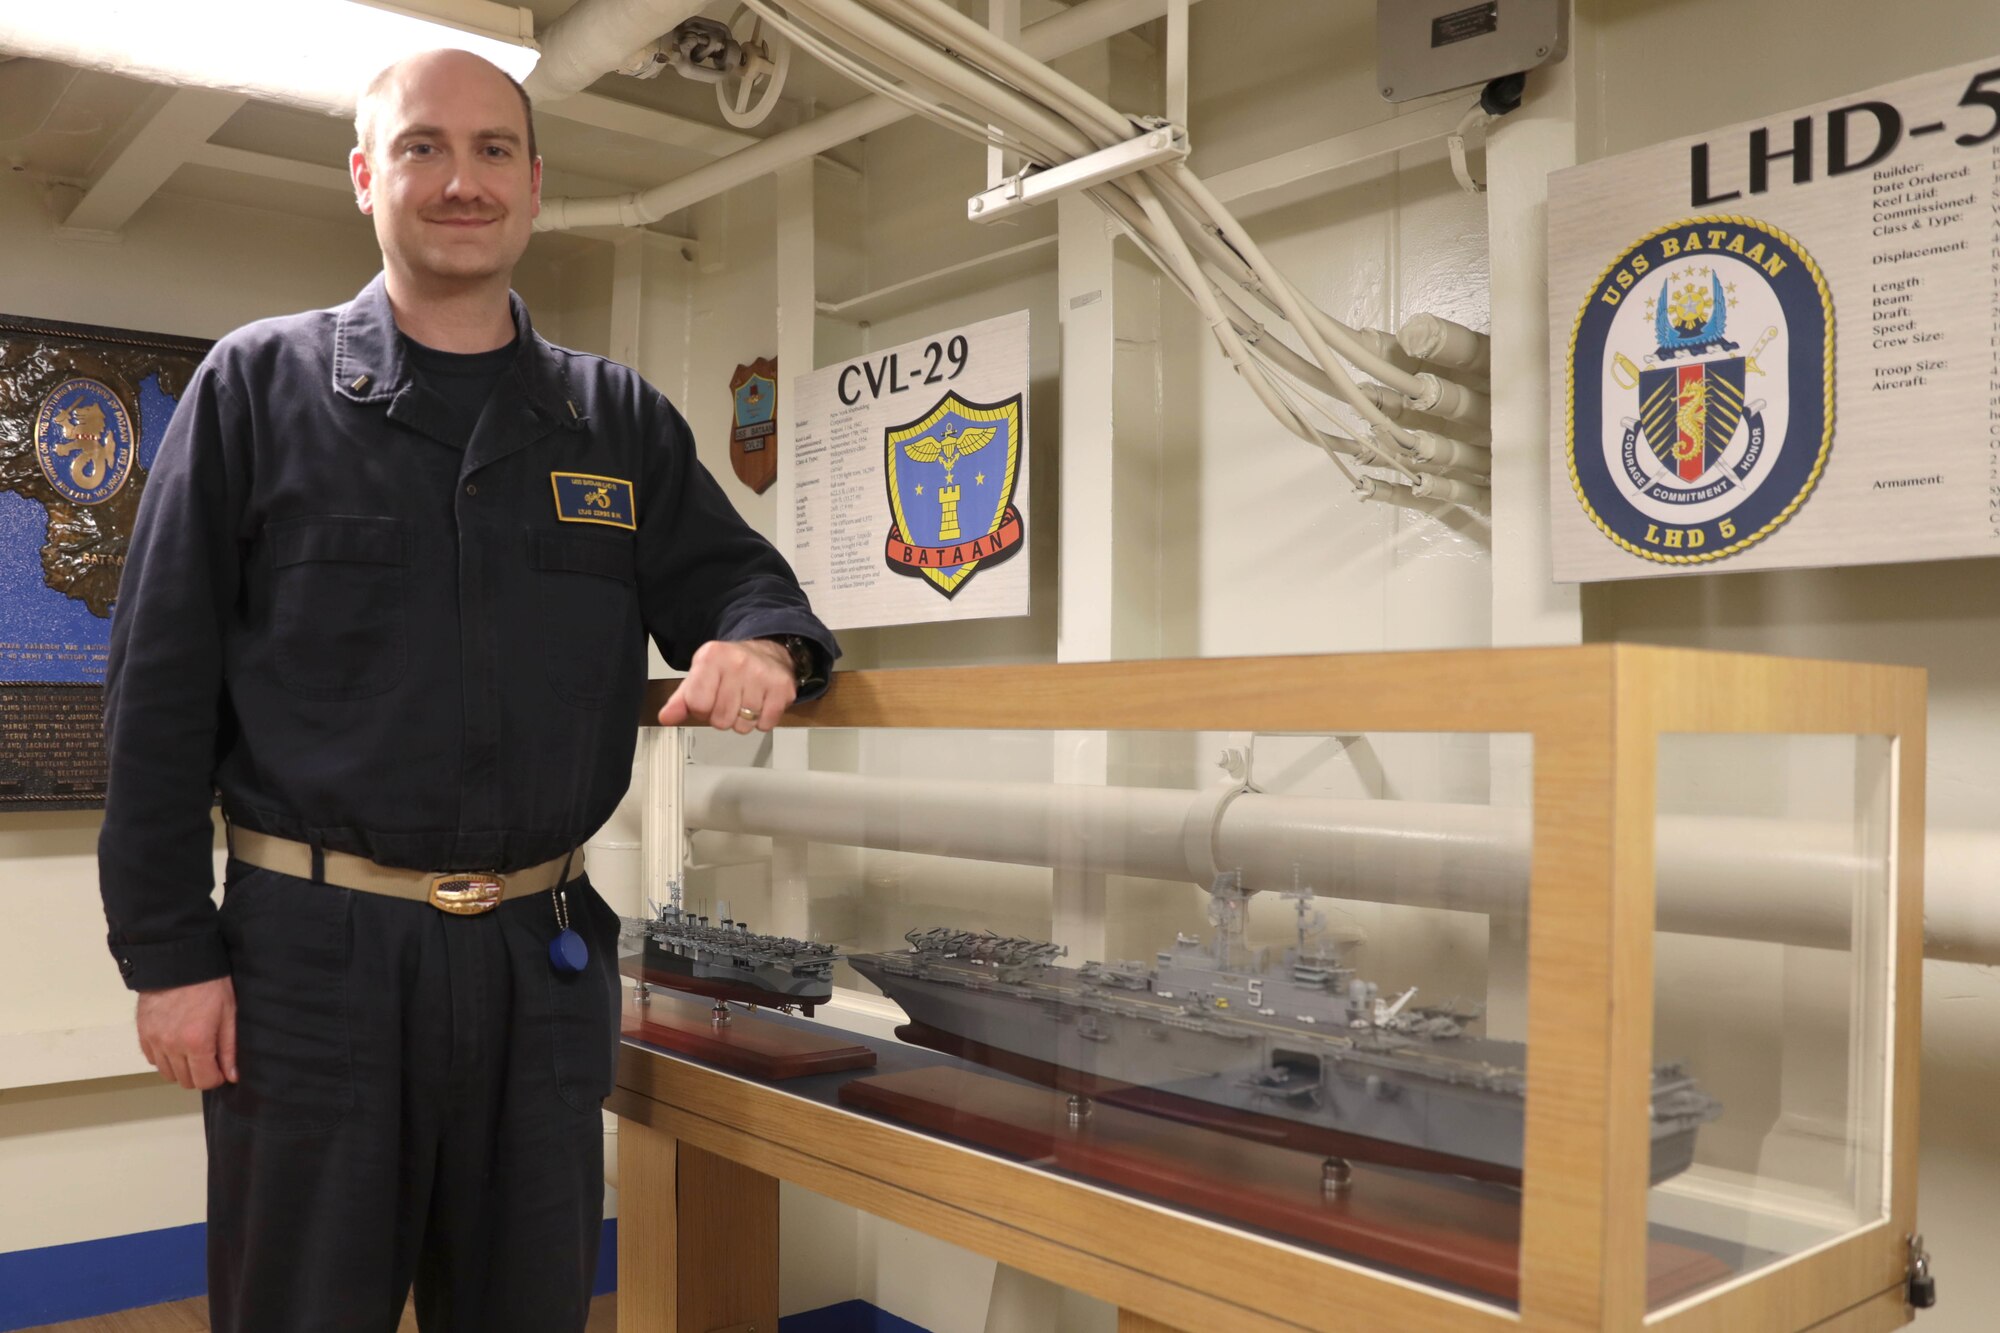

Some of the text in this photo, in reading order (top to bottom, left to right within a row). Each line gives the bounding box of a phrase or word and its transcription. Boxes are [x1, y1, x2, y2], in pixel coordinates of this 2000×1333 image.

[1691, 67, 2000, 208] LHD-5
[1873, 163, 1924, 181] Builder:
[1873, 166, 1971, 195] Date Ordered:
[1873, 187, 1938, 209] Keel Laid:
[1873, 193, 1977, 223] Commissioned:
[1873, 212, 1963, 237] Class & Type:
[1873, 240, 1969, 265] Displacement:
[1602, 230, 1788, 306] USS BATAAN
[1873, 293, 1913, 307] Beam:
[1873, 307, 1911, 321] Draft:
[1873, 320, 1917, 336] Speed:
[1873, 332, 1944, 349] Crew Size:
[838, 335, 969, 406] CVL-29
[1873, 360, 1948, 377] Troop Size:
[1872, 376, 1927, 391] Aircraft:
[1624, 433, 1646, 487] COURAGE
[1740, 427, 1761, 471] HONOR
[1653, 481, 1728, 502] COMMITMENT
[1873, 474, 1944, 490] Armament:
[598, 488, 611, 508] 5
[1644, 518, 1736, 548] LHD 5
[83, 551, 124, 566] BATAA
[903, 532, 1003, 566] BATAAN
[1247, 979, 1262, 1007] 5
